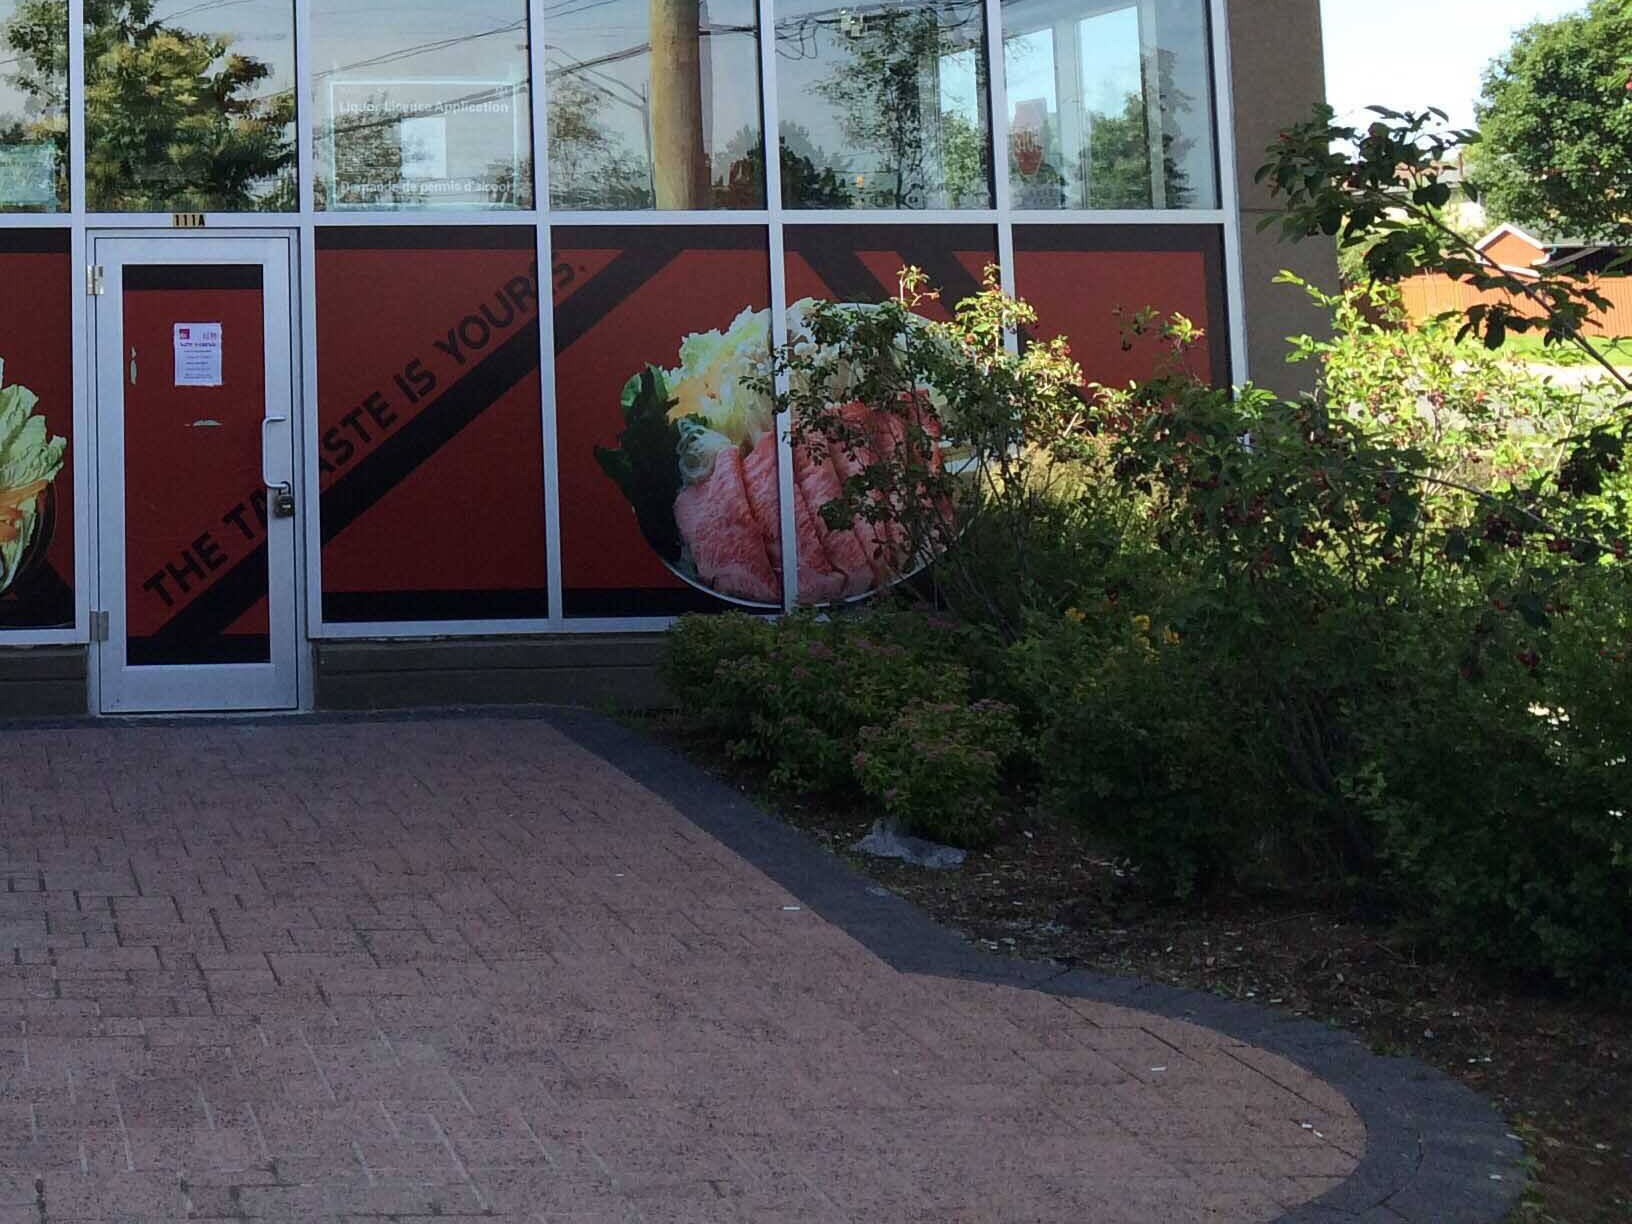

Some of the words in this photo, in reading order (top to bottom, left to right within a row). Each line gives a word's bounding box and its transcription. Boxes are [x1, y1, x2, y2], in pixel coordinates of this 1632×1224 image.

[339, 101, 382, 114] Liquor
[434, 101, 509, 114] Application
[341, 181, 400, 193] Demande
[403, 181, 417, 192] de
[420, 182, 461, 194] permis
[175, 214, 206, 226] 111A
[143, 529, 229, 608] THE
[395, 358, 438, 404] IS
